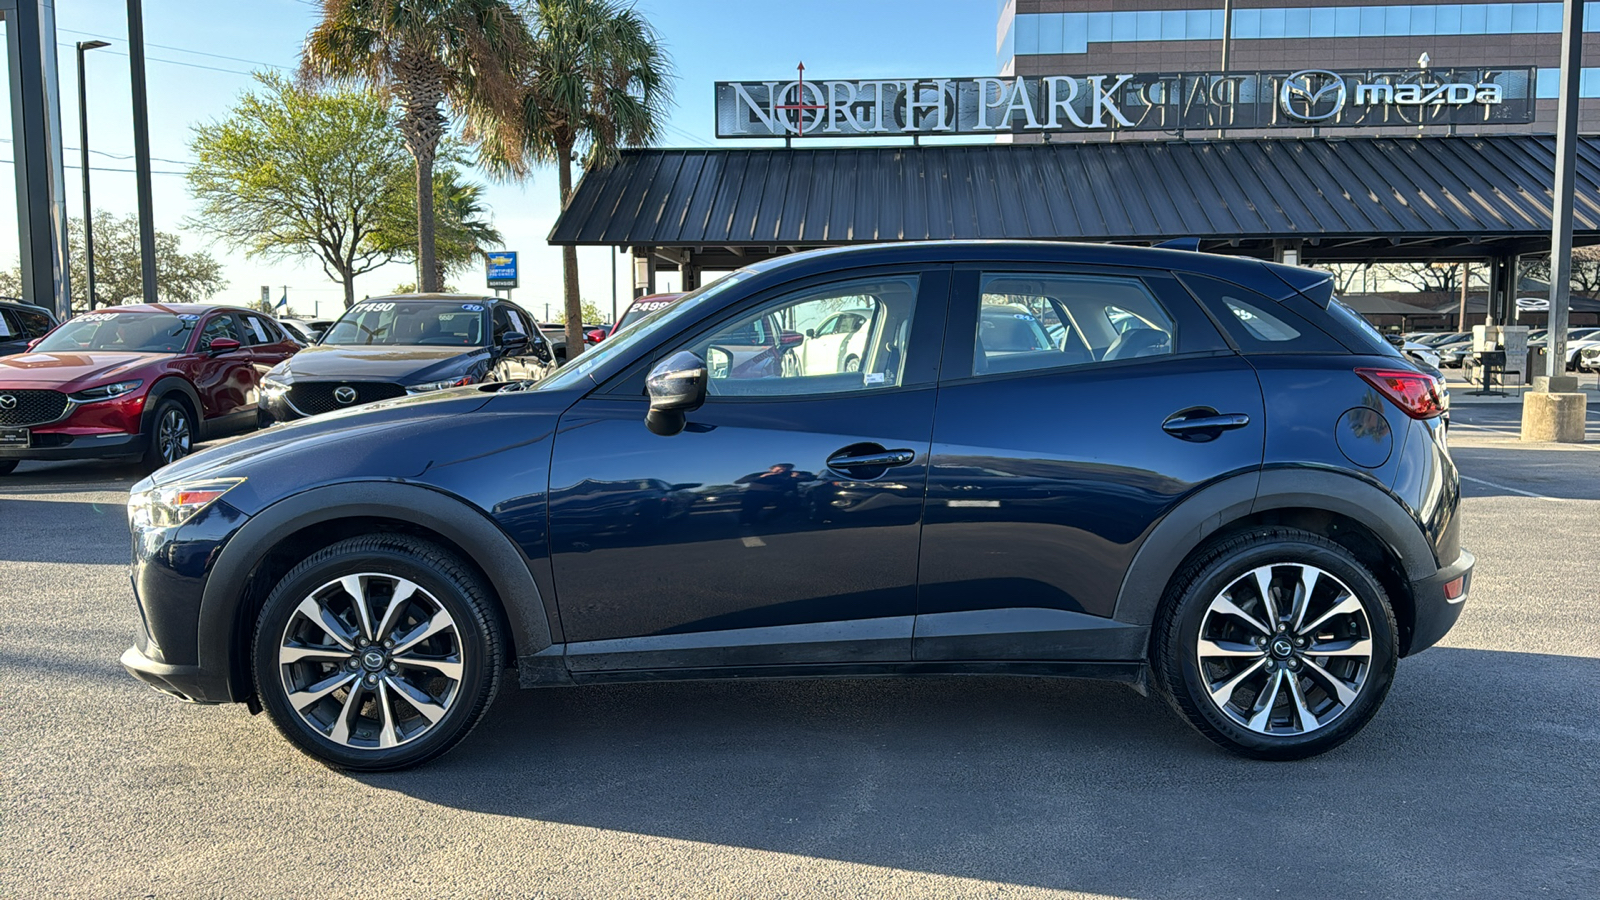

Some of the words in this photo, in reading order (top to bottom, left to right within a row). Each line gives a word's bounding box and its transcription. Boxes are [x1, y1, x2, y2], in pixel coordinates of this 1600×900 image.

[728, 79, 951, 134] NORTH
[973, 74, 1135, 129] PARK
[1354, 83, 1502, 105] mazda
[349, 302, 396, 314] 17490
